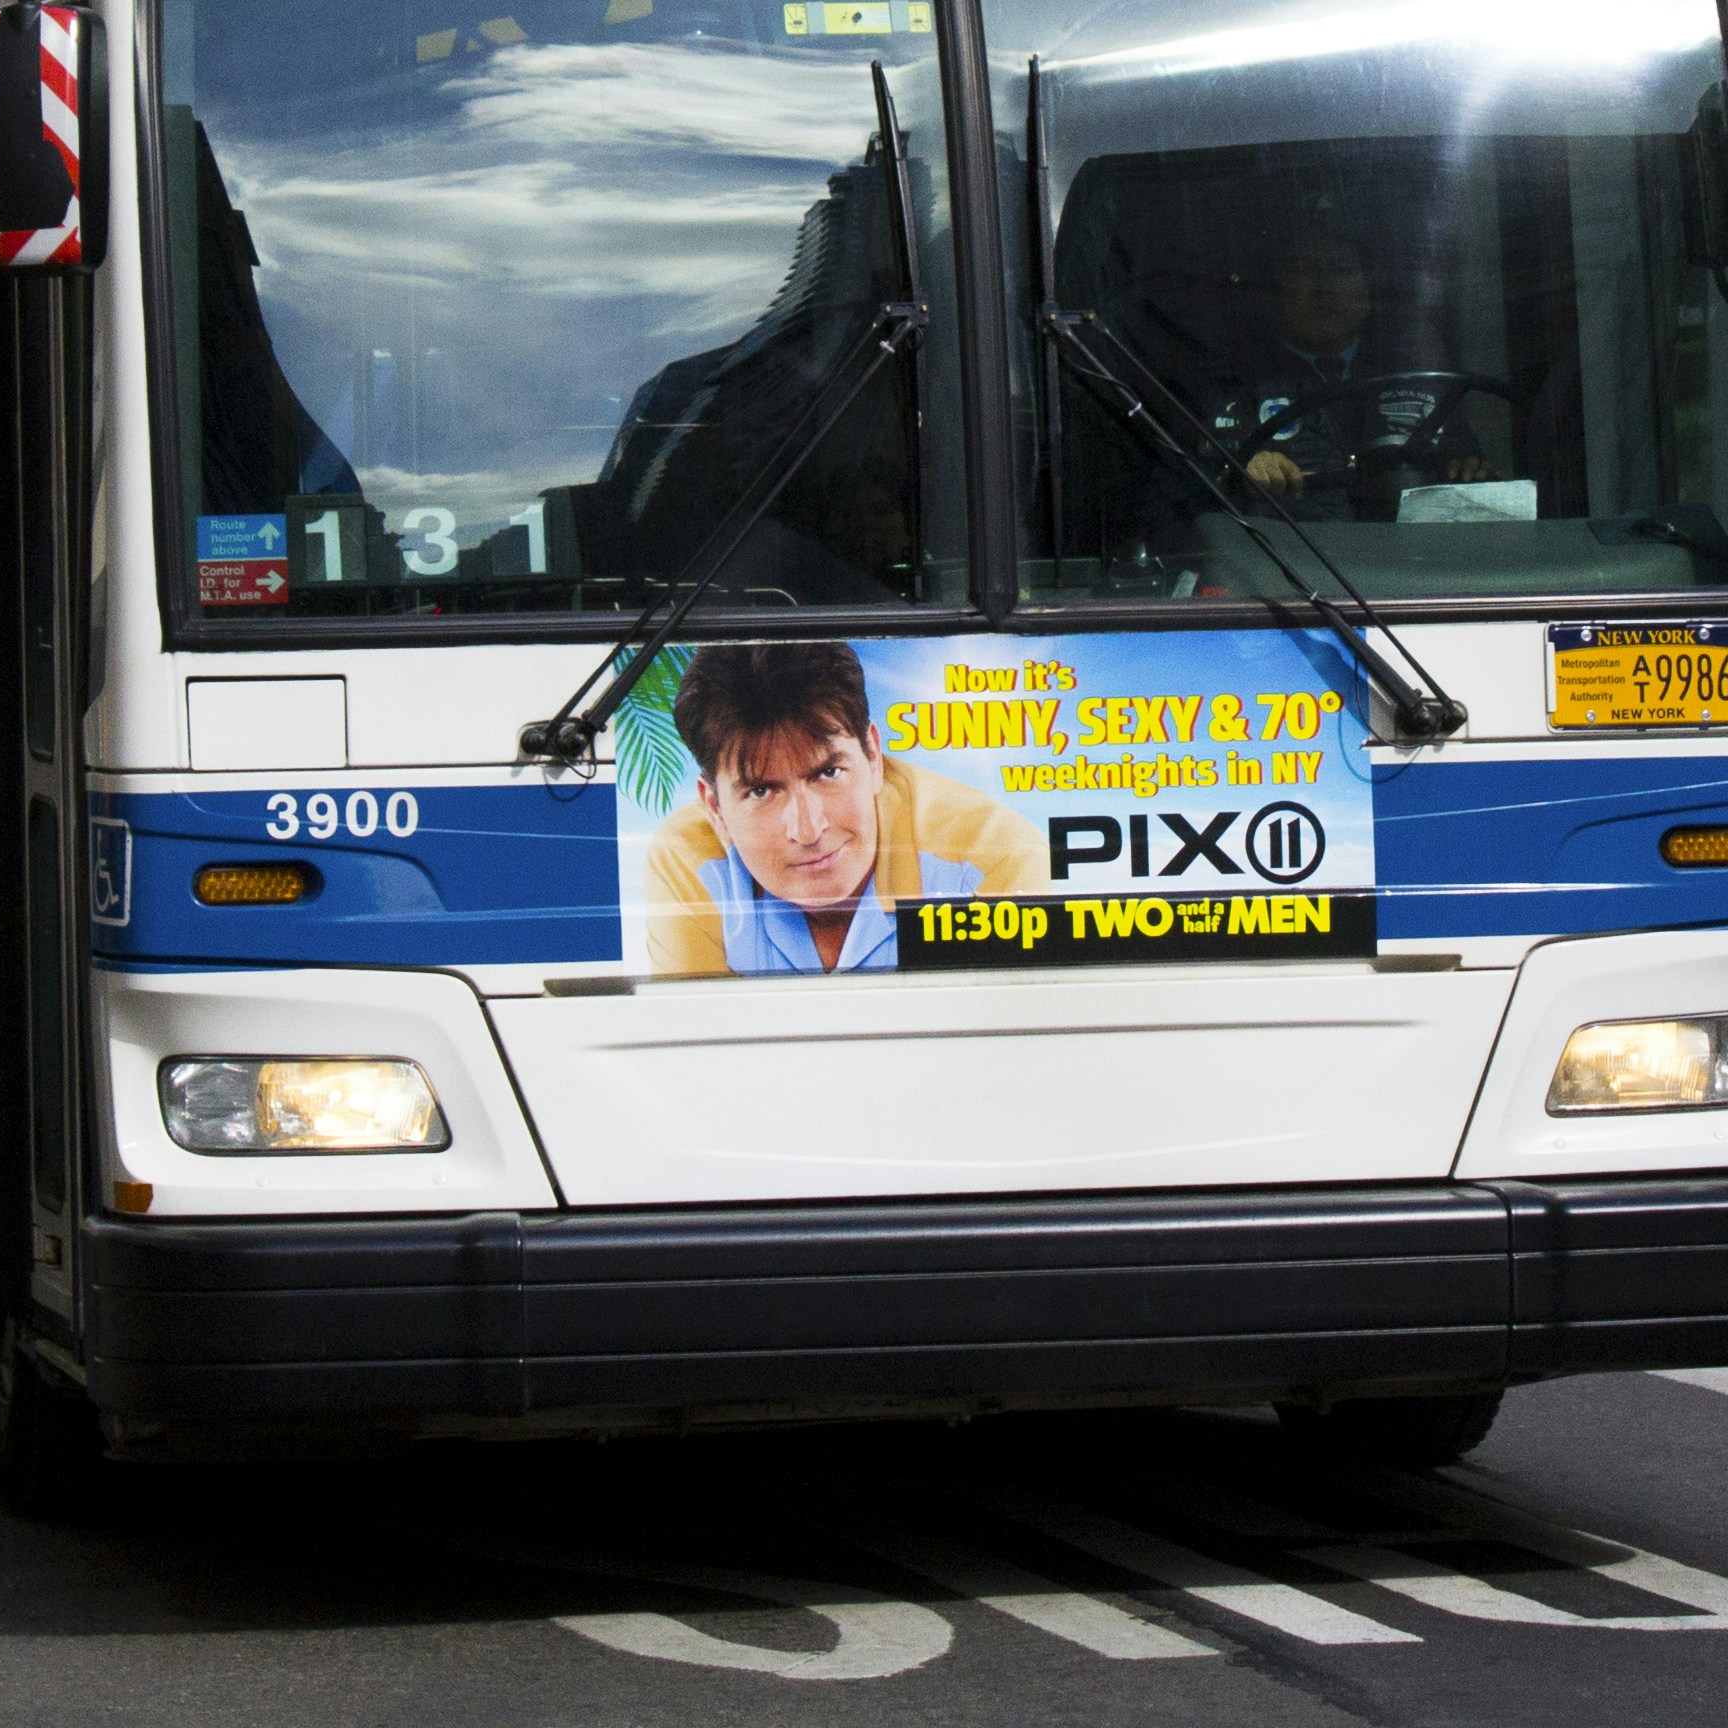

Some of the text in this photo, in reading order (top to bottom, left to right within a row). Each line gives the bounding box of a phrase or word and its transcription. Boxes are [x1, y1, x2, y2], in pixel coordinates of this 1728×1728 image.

[211, 520, 247, 530] Route
[211, 532, 257, 543] number
[212, 546, 249, 555] above
[200, 565, 245, 576] Control
[200, 578, 241, 588] I.D. for
[200, 590, 262, 601] M.T.A. use
[1597, 628, 1696, 646] NEW YORK
[1561, 659, 1620, 670] Metropolitan
[945, 659, 1077, 693] Now it's
[1558, 675, 1626, 686] Transportation
[1570, 692, 1614, 703] Authority
[1611, 708, 1685, 720] NEW YORK
[886, 689, 1344, 755] SUNNY, SEXY & 70°
[1001, 750, 1323, 798] weeknights in NY
[266, 791, 419, 840] 3900
[1048, 811, 1245, 880] PIX
[1177, 900, 1225, 917] and a
[1227, 894, 1331, 936] MEN
[918, 898, 1174, 949] 11:30p TWO
[1182, 915, 1220, 934] half
